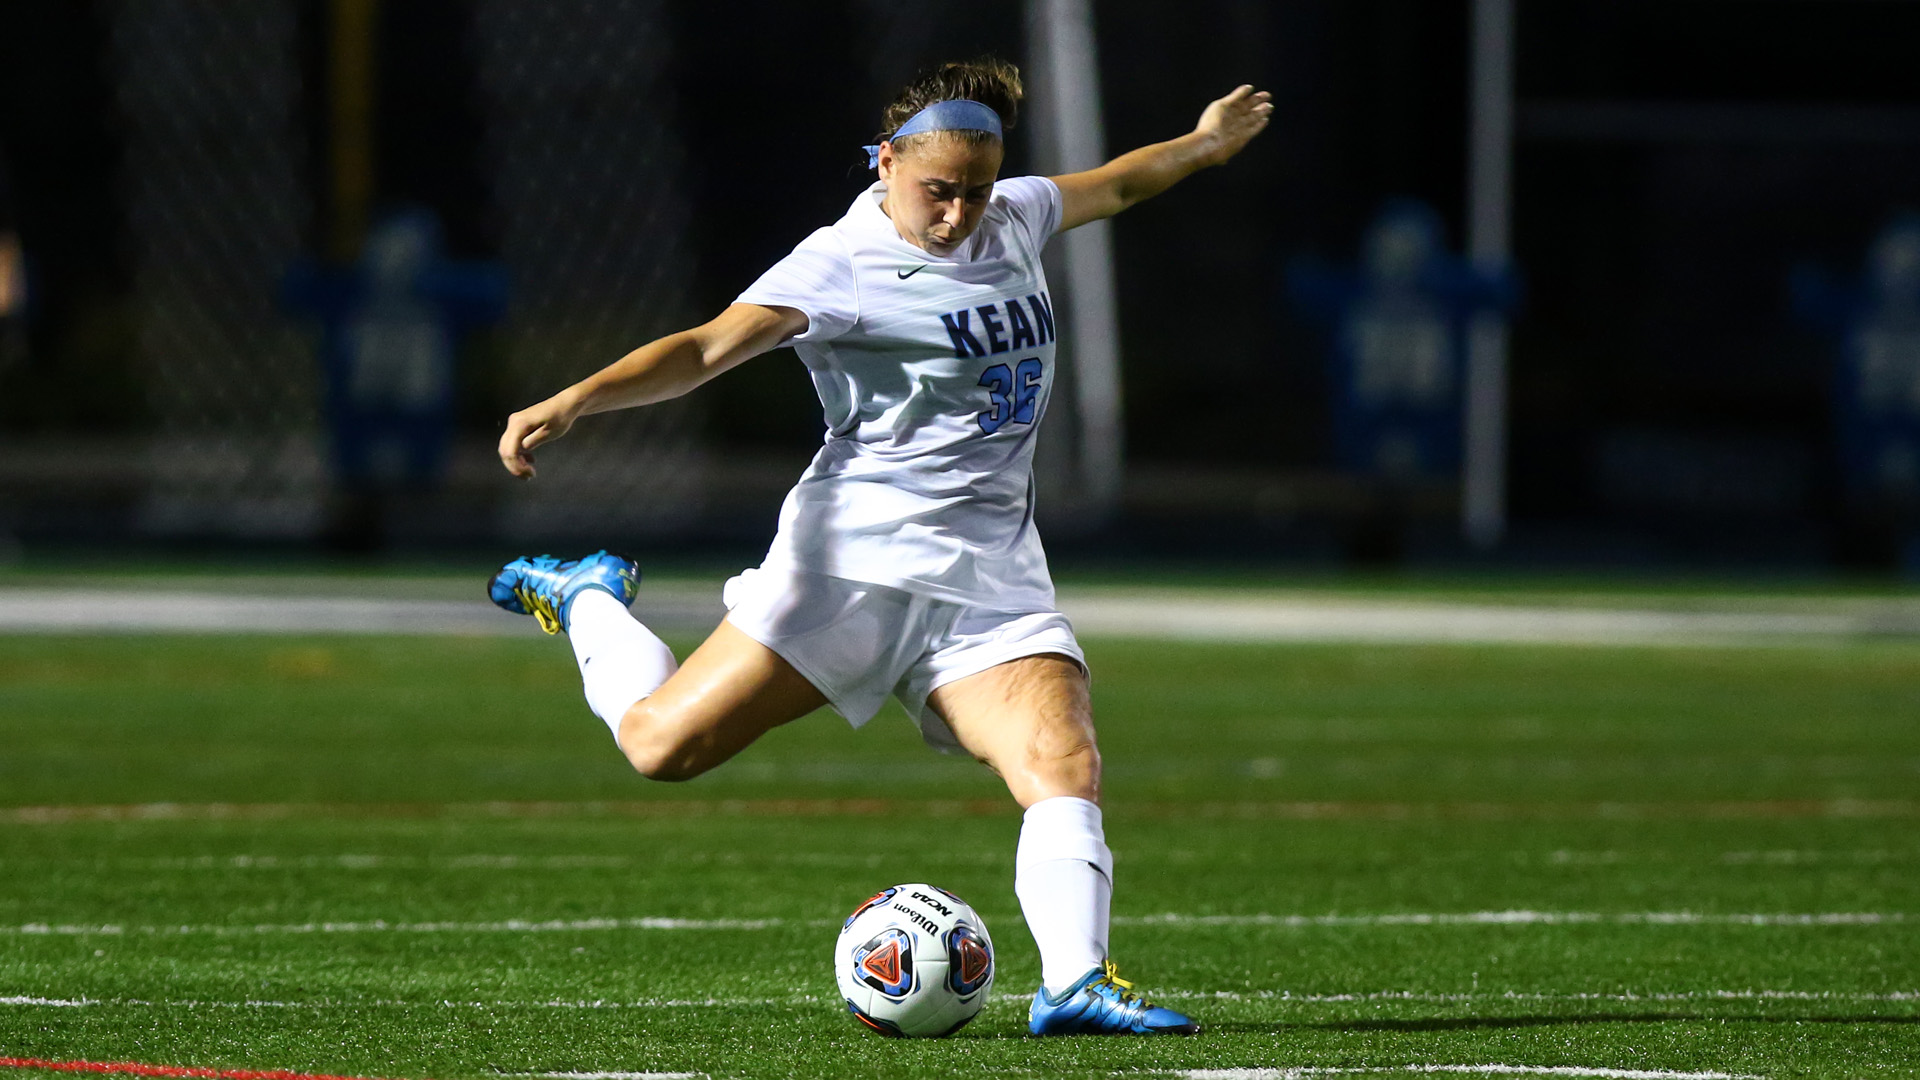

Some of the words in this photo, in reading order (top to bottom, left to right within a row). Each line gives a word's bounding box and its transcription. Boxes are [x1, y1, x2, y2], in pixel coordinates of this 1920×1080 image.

[940, 291, 1055, 358] KEAN
[977, 357, 1042, 435] 36
[894, 903, 939, 937] Wilson
[911, 892, 952, 917] NCAA
